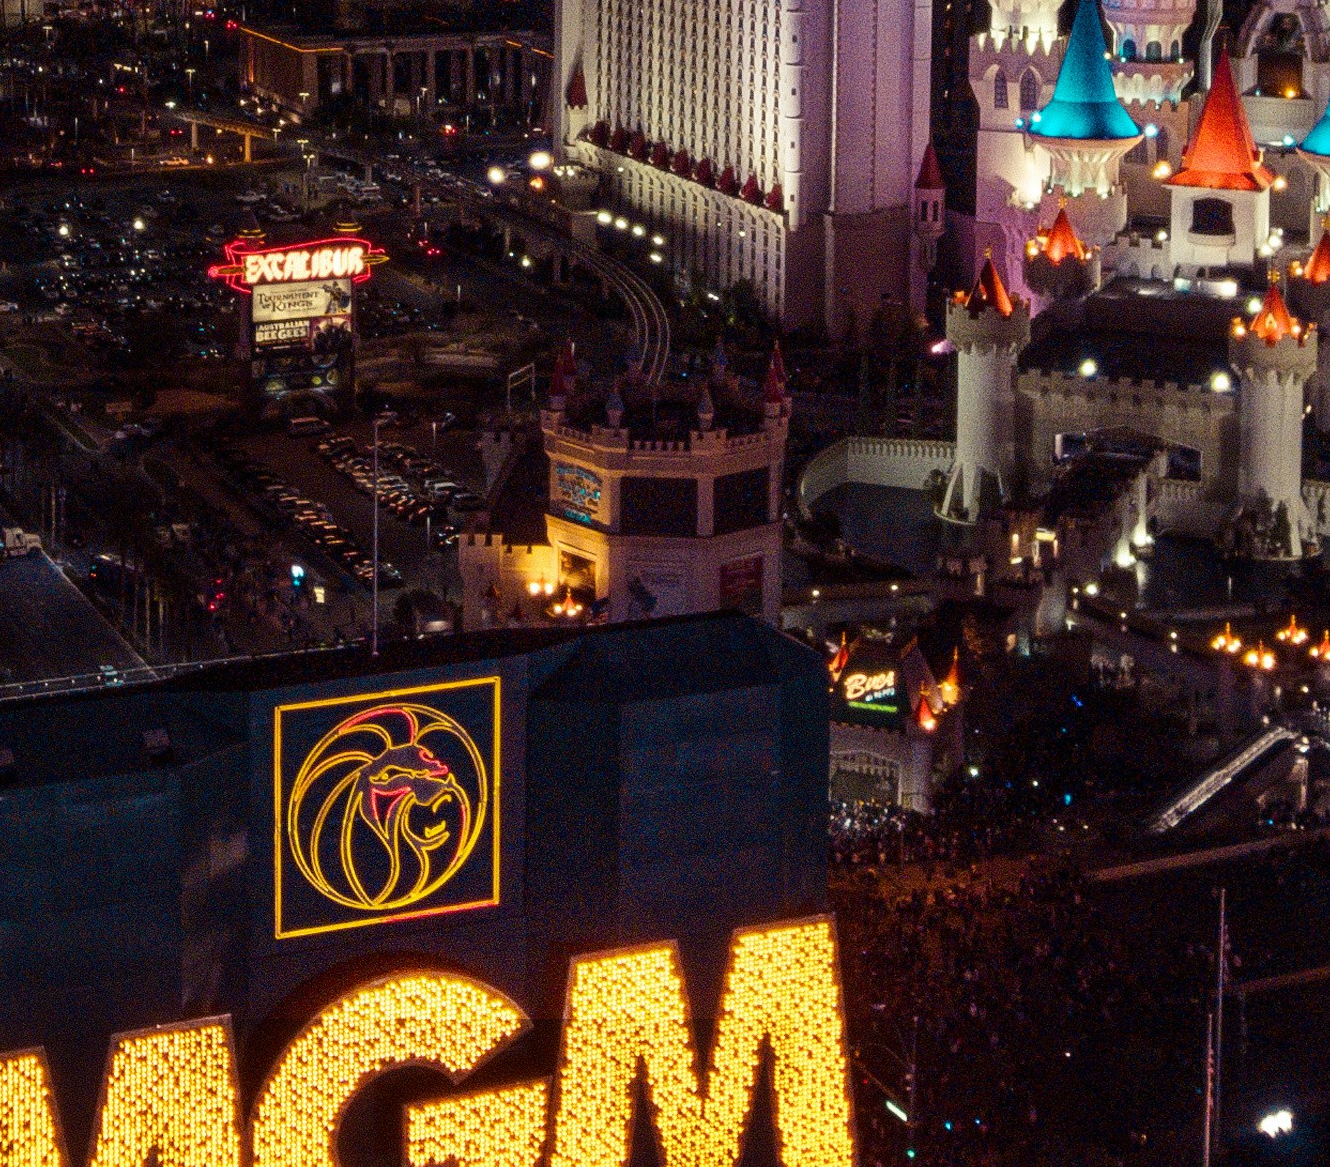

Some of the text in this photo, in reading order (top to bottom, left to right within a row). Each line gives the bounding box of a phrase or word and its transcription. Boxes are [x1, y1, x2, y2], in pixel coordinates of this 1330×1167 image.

[245, 246, 364, 284] EXCALIBUR
[258, 320, 310, 331] AUSTRALIAN
[256, 327, 306, 343] BEE GEES
